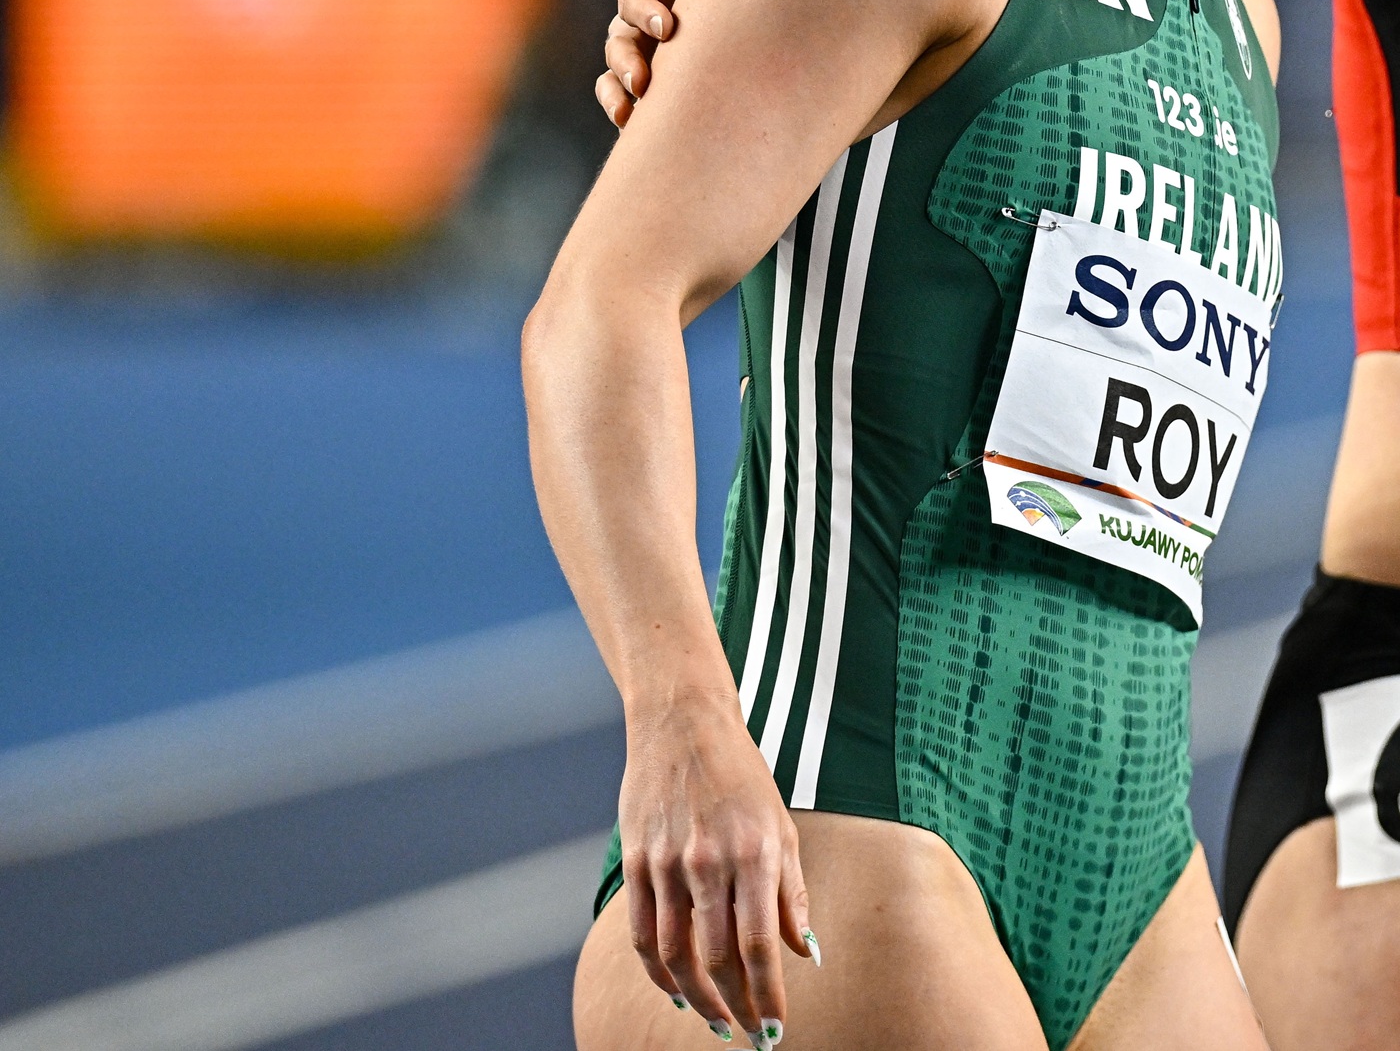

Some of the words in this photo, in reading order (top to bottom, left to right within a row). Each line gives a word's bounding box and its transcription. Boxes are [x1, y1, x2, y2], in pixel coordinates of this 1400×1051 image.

[1073, 146, 1283, 310] IRELAND
[1066, 254, 1270, 396] SONY
[1093, 377, 1237, 518] ROY
[1099, 513, 1181, 563] KUJAWY
